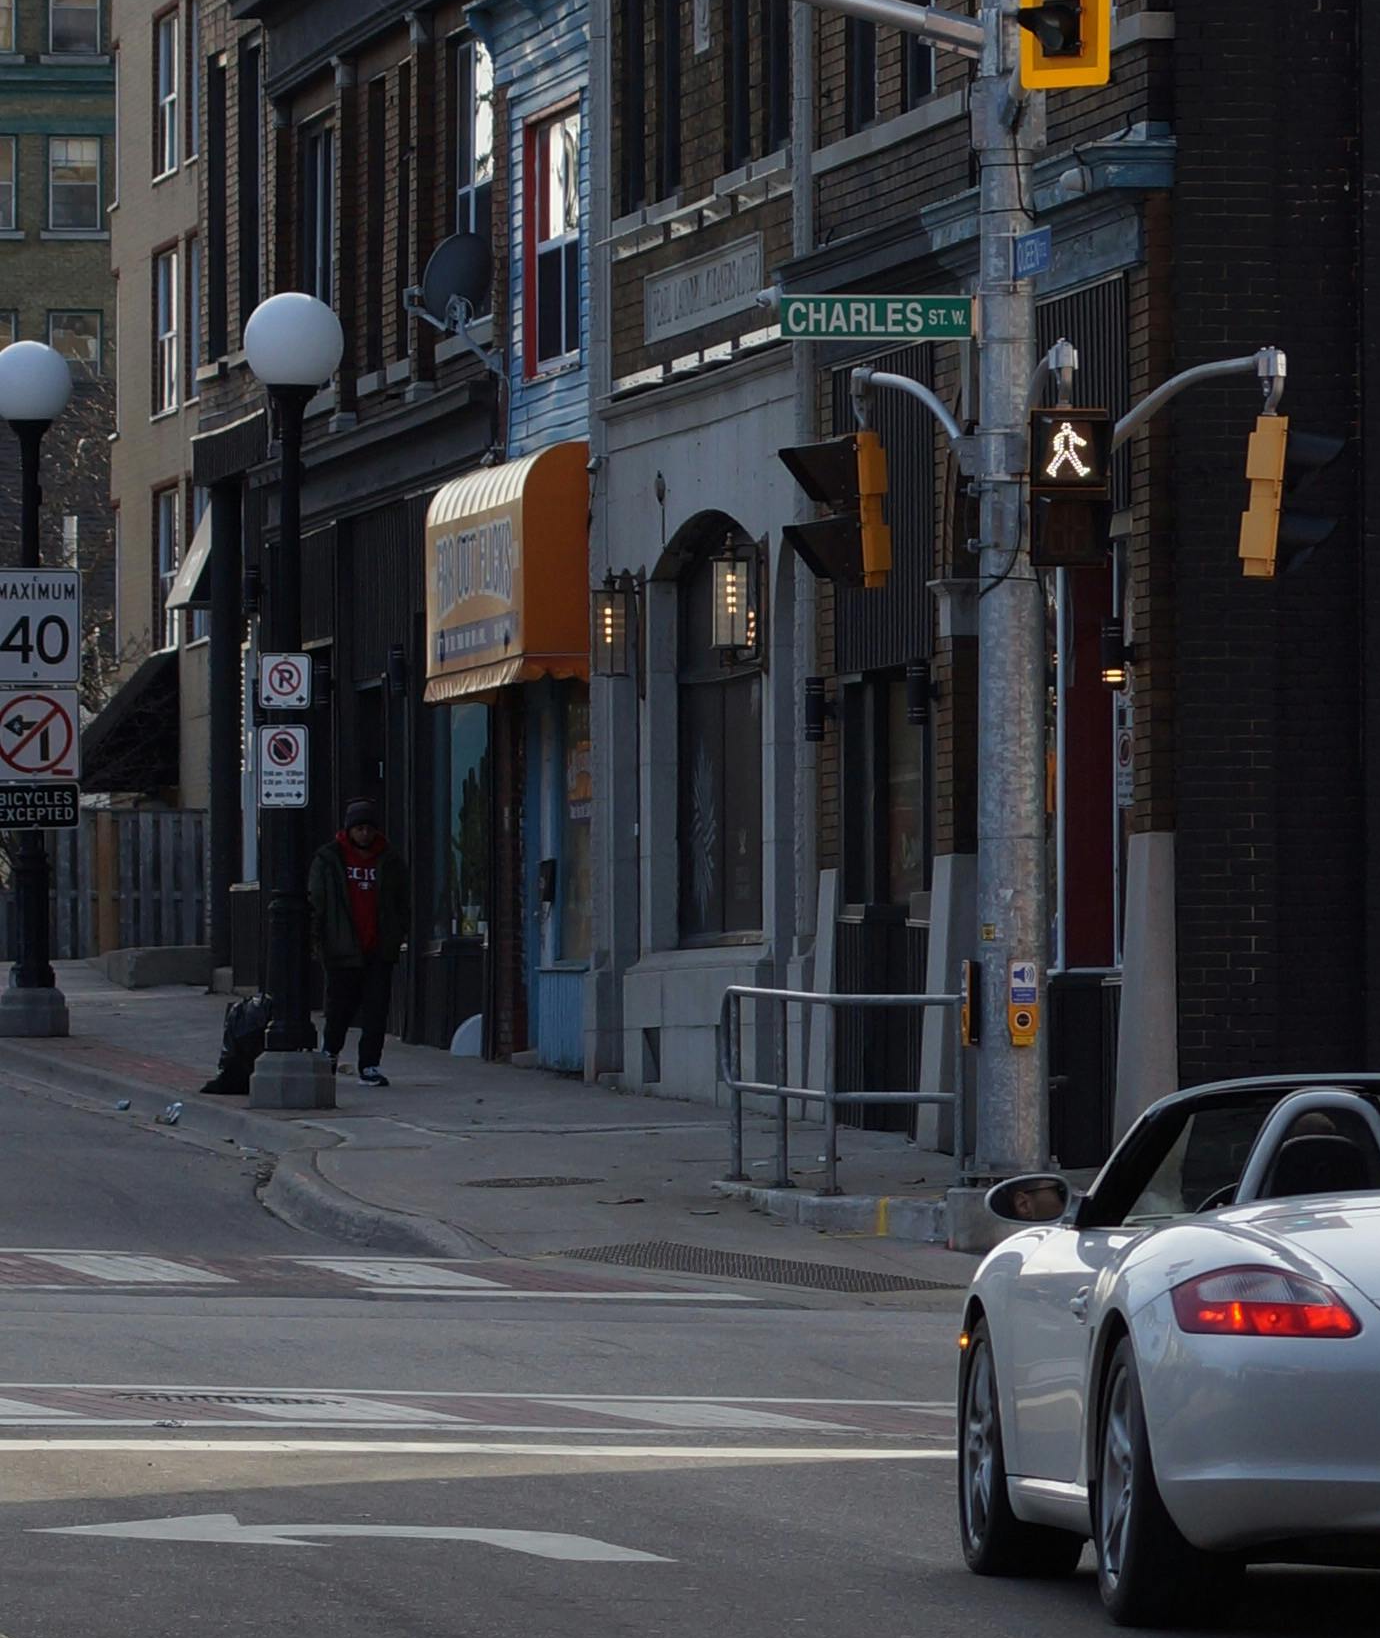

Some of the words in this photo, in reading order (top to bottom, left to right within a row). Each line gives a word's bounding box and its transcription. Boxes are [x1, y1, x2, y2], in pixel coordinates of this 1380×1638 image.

[787, 301, 924, 333] CHARLES
[928, 309, 948, 326] ST.
[951, 309, 967, 326] W.
[0, 582, 76, 600] MAXIMUM
[0, 615, 69, 664] 40
